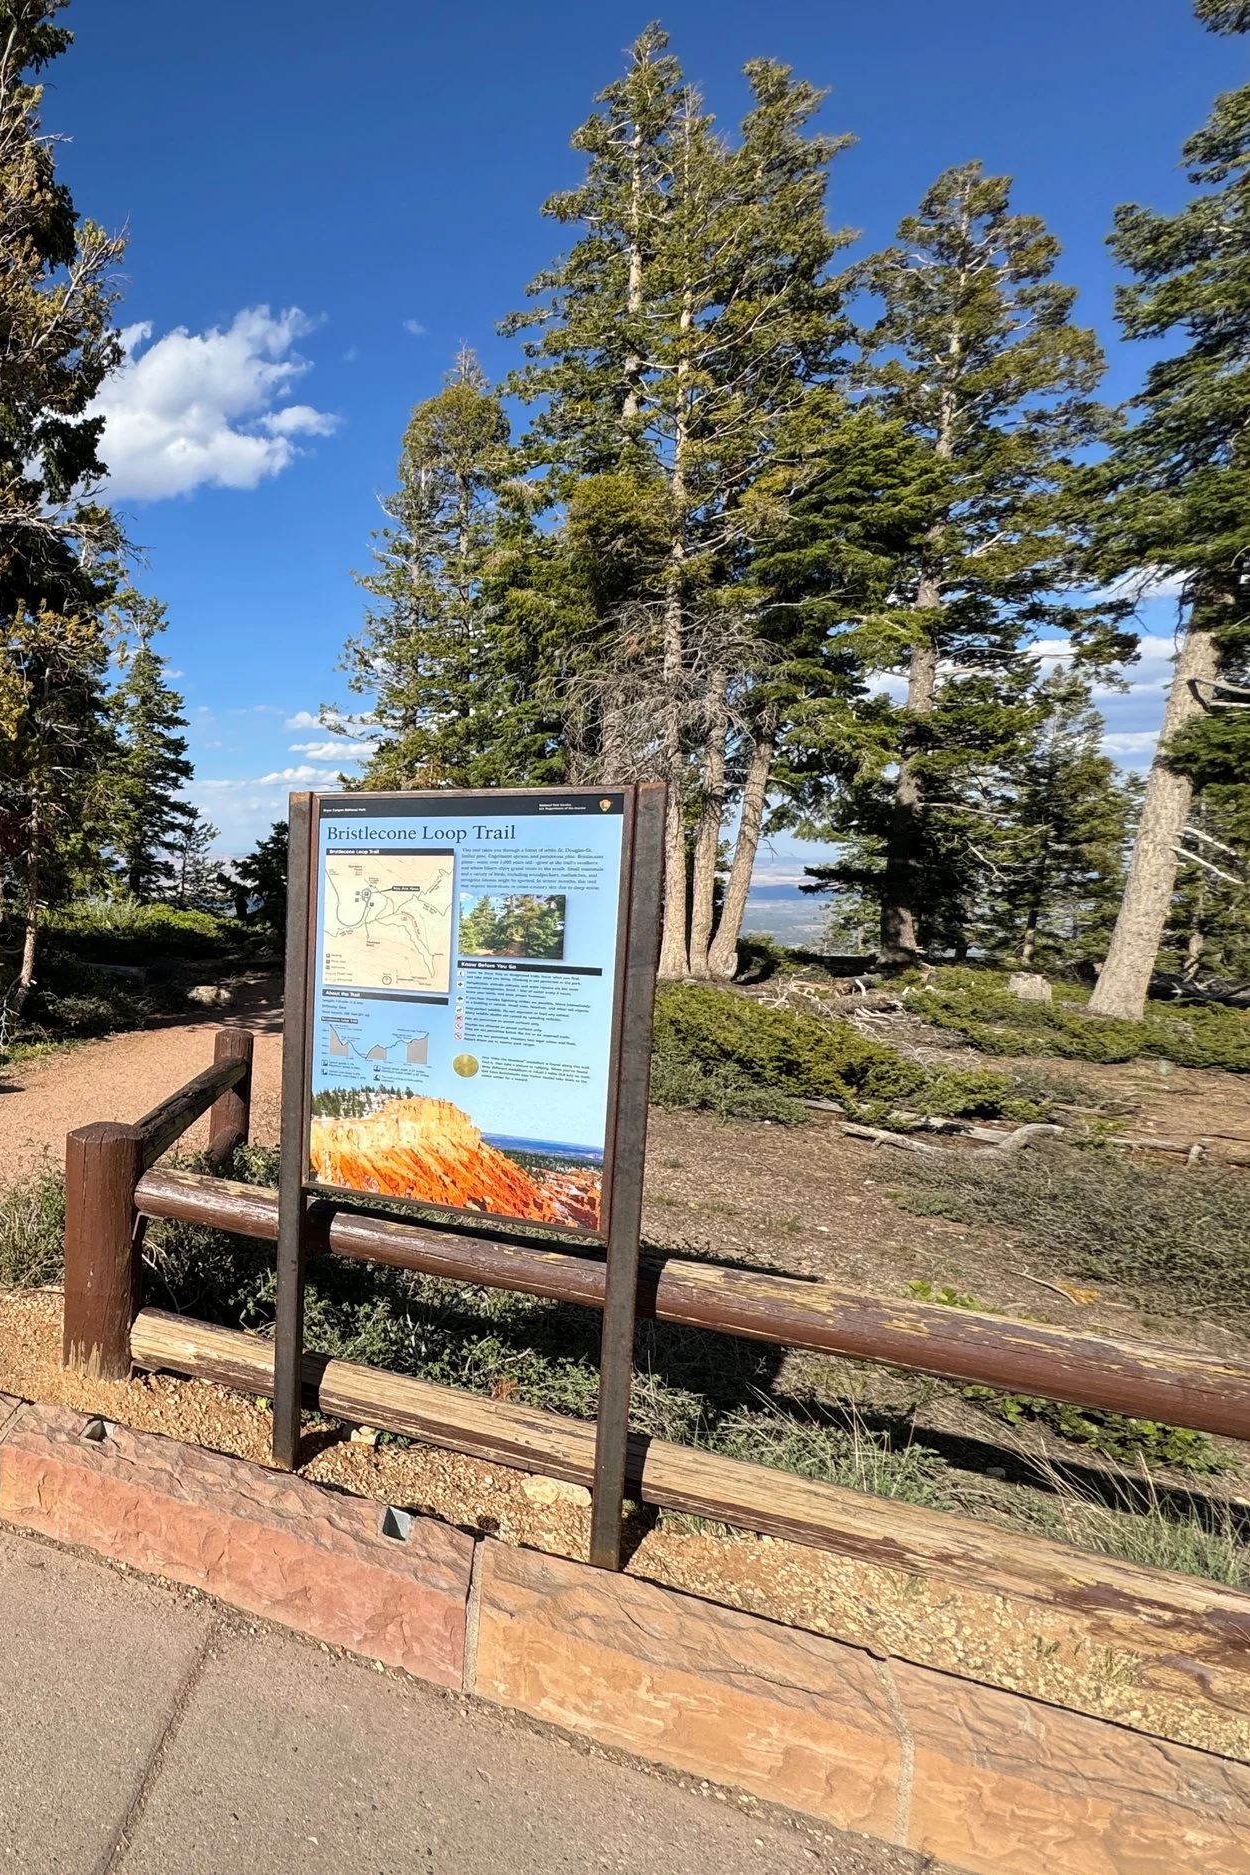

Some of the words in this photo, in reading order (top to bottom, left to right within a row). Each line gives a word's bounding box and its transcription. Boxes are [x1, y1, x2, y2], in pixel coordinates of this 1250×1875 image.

[327, 826, 417, 840] Bristlecone
[421, 825, 467, 844] Loop
[472, 825, 516, 840] Trail
